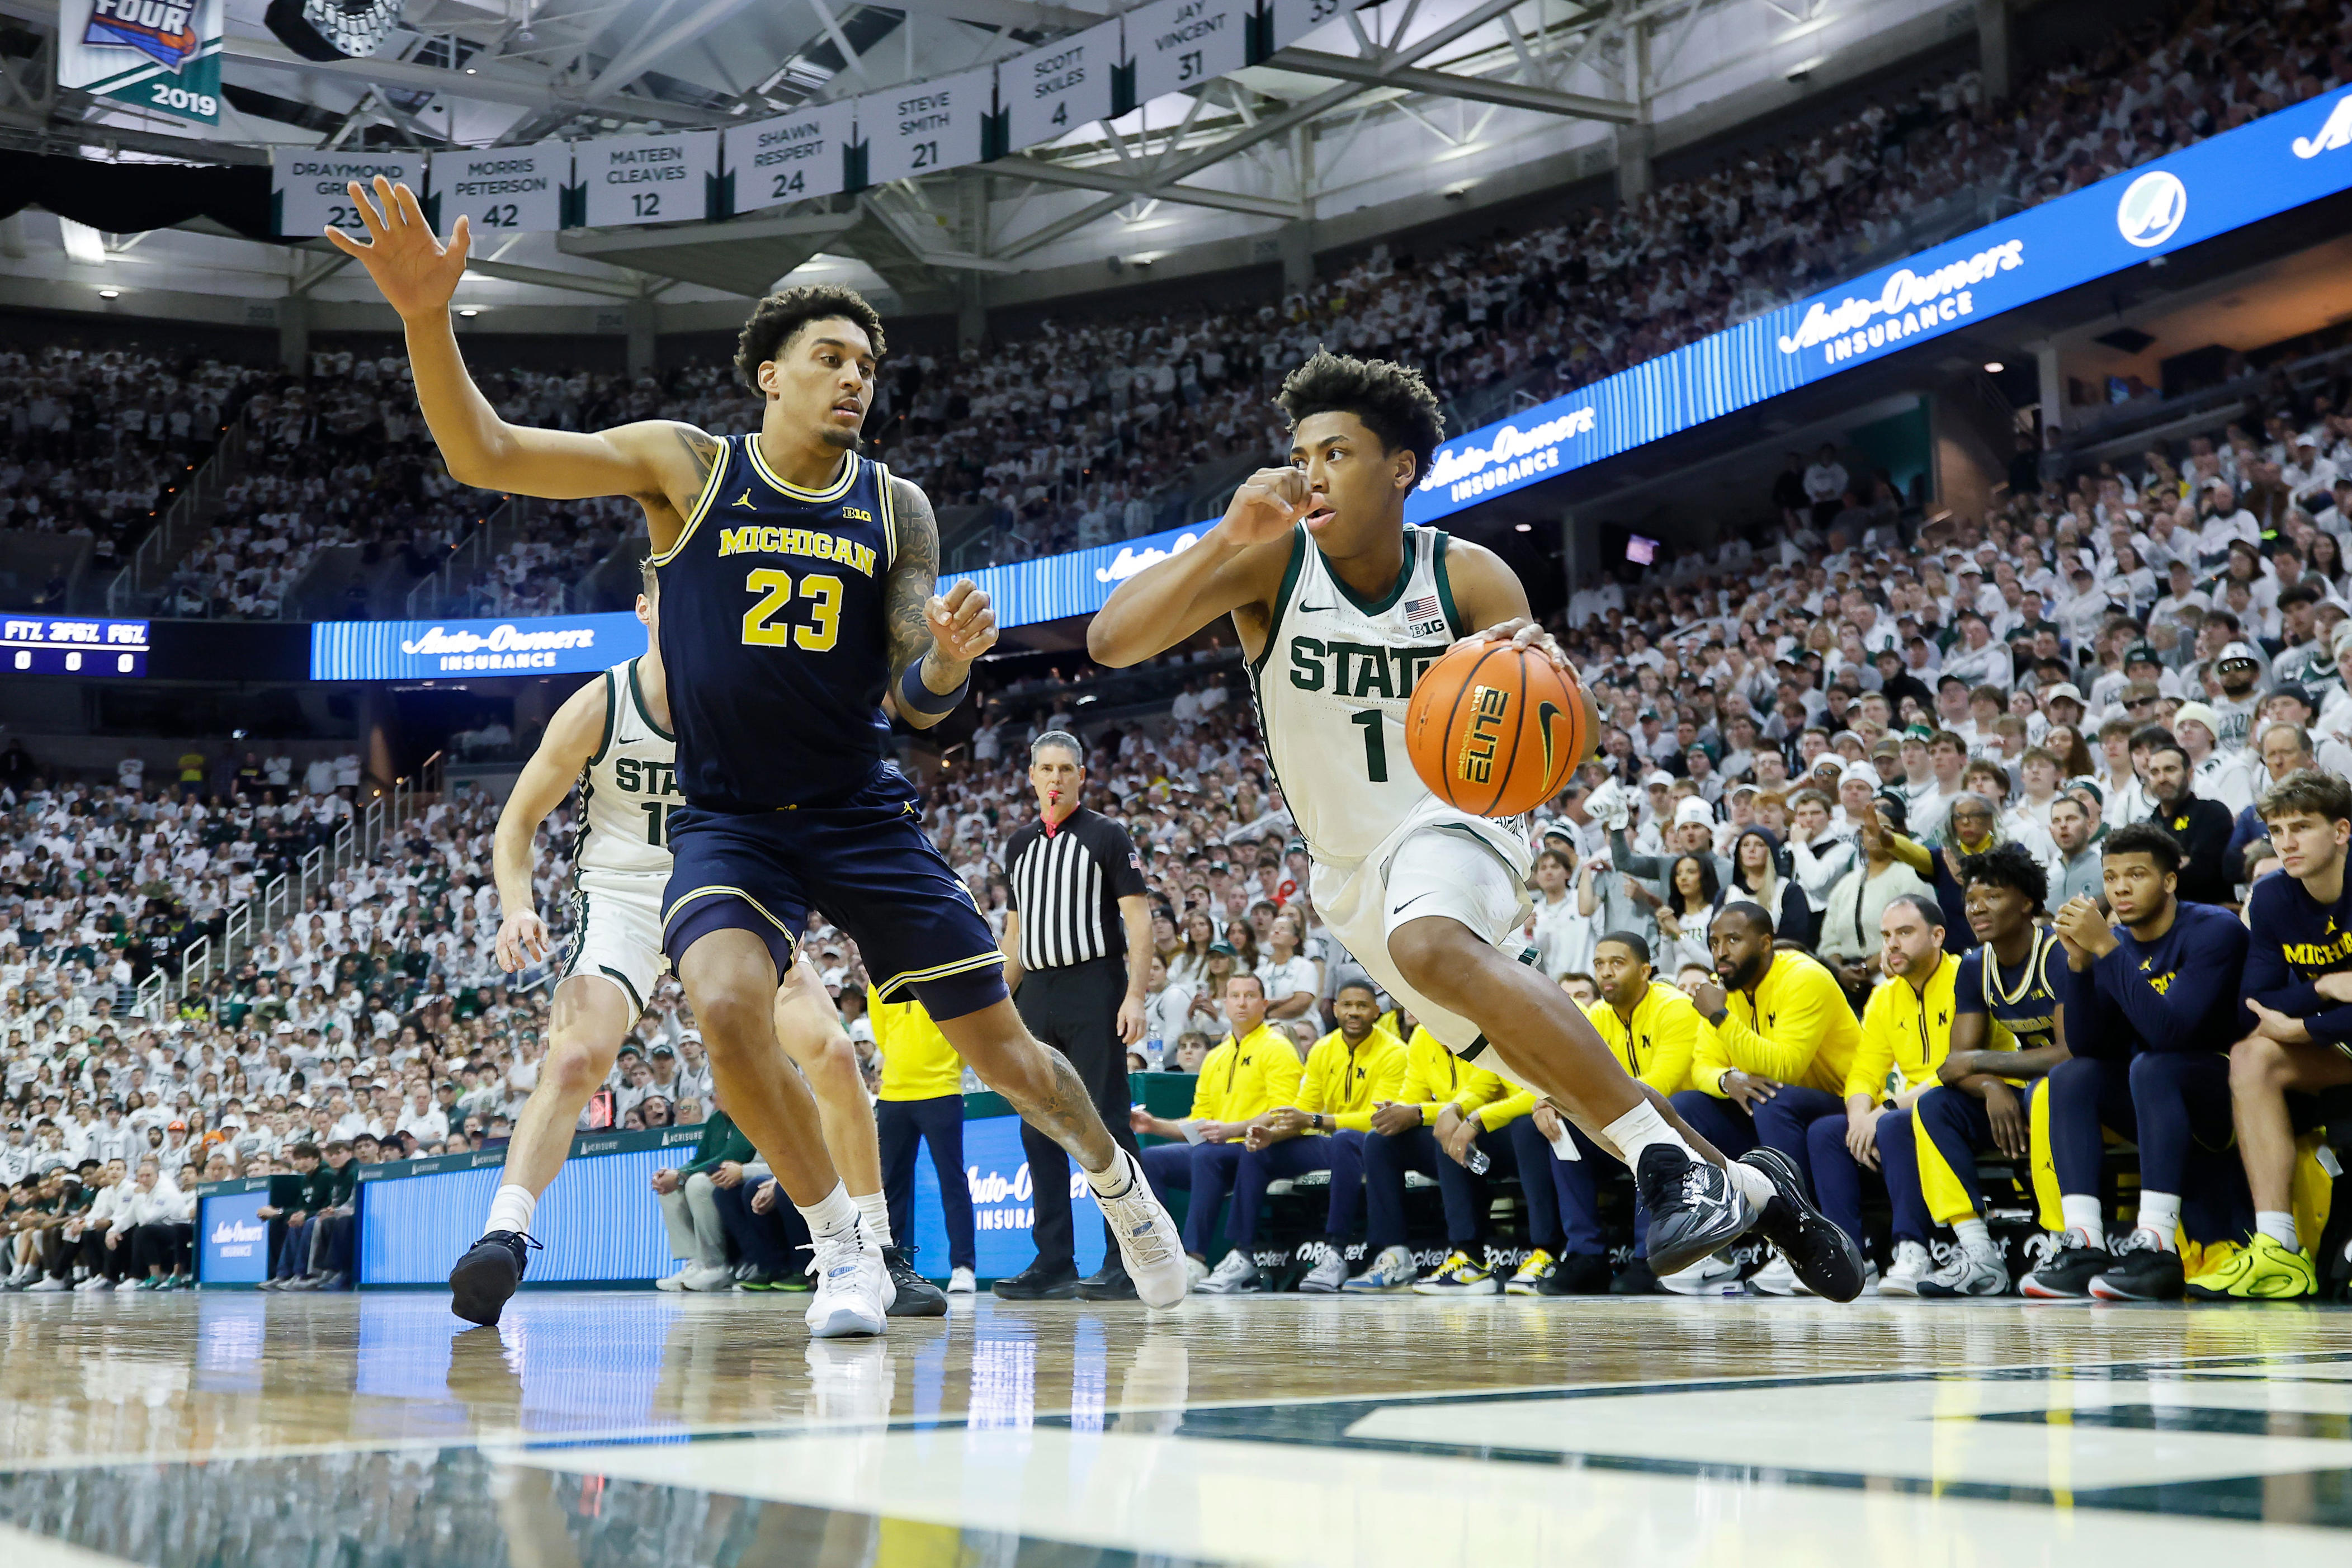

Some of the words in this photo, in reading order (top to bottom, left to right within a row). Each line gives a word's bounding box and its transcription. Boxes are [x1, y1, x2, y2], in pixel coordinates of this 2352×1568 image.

[1174, 0, 1206, 24] JAY
[1154, 13, 1227, 51] VINCENT
[1034, 46, 1084, 78] SCOTT
[1178, 50, 1203, 81] 31
[1035, 68, 1085, 98] SKILES
[151, 83, 217, 116] 2019
[898, 91, 951, 116] STEVE
[899, 113, 951, 136] SMITH
[1051, 101, 1068, 126] 4
[758, 121, 820, 148] SHAWN
[610, 147, 683, 165] MATEEN
[754, 140, 824, 167] RESPERT
[911, 141, 938, 168] 21
[292, 163, 404, 178] DRAYMOND
[467, 159, 534, 177] MORRIS
[606, 166, 686, 185] CLEAVES
[455, 177, 547, 196] PETERSON
[771, 169, 805, 199] 24
[328, 206, 363, 228] 23
[483, 204, 518, 227] 42
[631, 193, 660, 217] 12
[1778, 239, 2024, 354] Auto-Owners
[1825, 291, 1973, 364] INSURANCE
[1419, 406, 1594, 492] Auto-Owners
[1451, 447, 1559, 503] INSURANCE
[718, 526, 876, 578] MICHIGAN
[742, 568, 844, 652] 23
[4, 620, 44, 641] FT%
[402, 624, 594, 654] Auto-Owners
[15, 650, 31, 670] 0
[65, 651, 82, 672] 0
[117, 653, 134, 673] 0
[440, 651, 556, 671] INSURANCE
[1352, 709, 1388, 782] 1
[1465, 685, 1511, 785] ELITE
